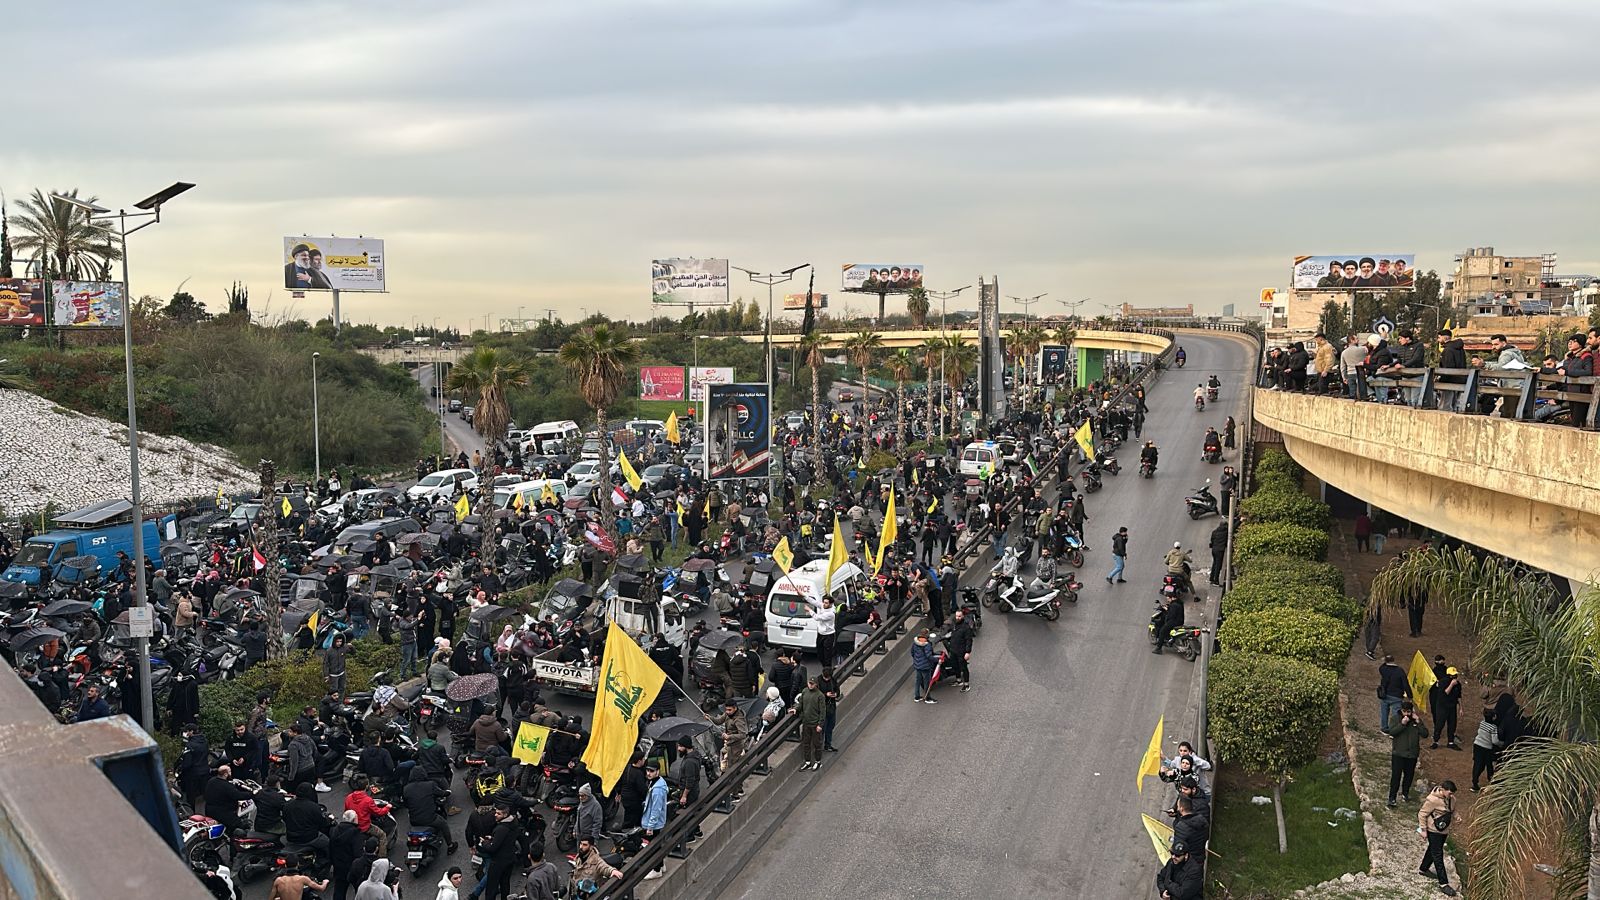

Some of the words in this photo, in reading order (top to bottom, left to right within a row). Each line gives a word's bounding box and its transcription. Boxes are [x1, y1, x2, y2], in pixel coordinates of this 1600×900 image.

[92, 536, 107, 545] ST
[778, 583, 811, 593] AMBULANCE
[542, 665, 582, 678] TOYOTA
